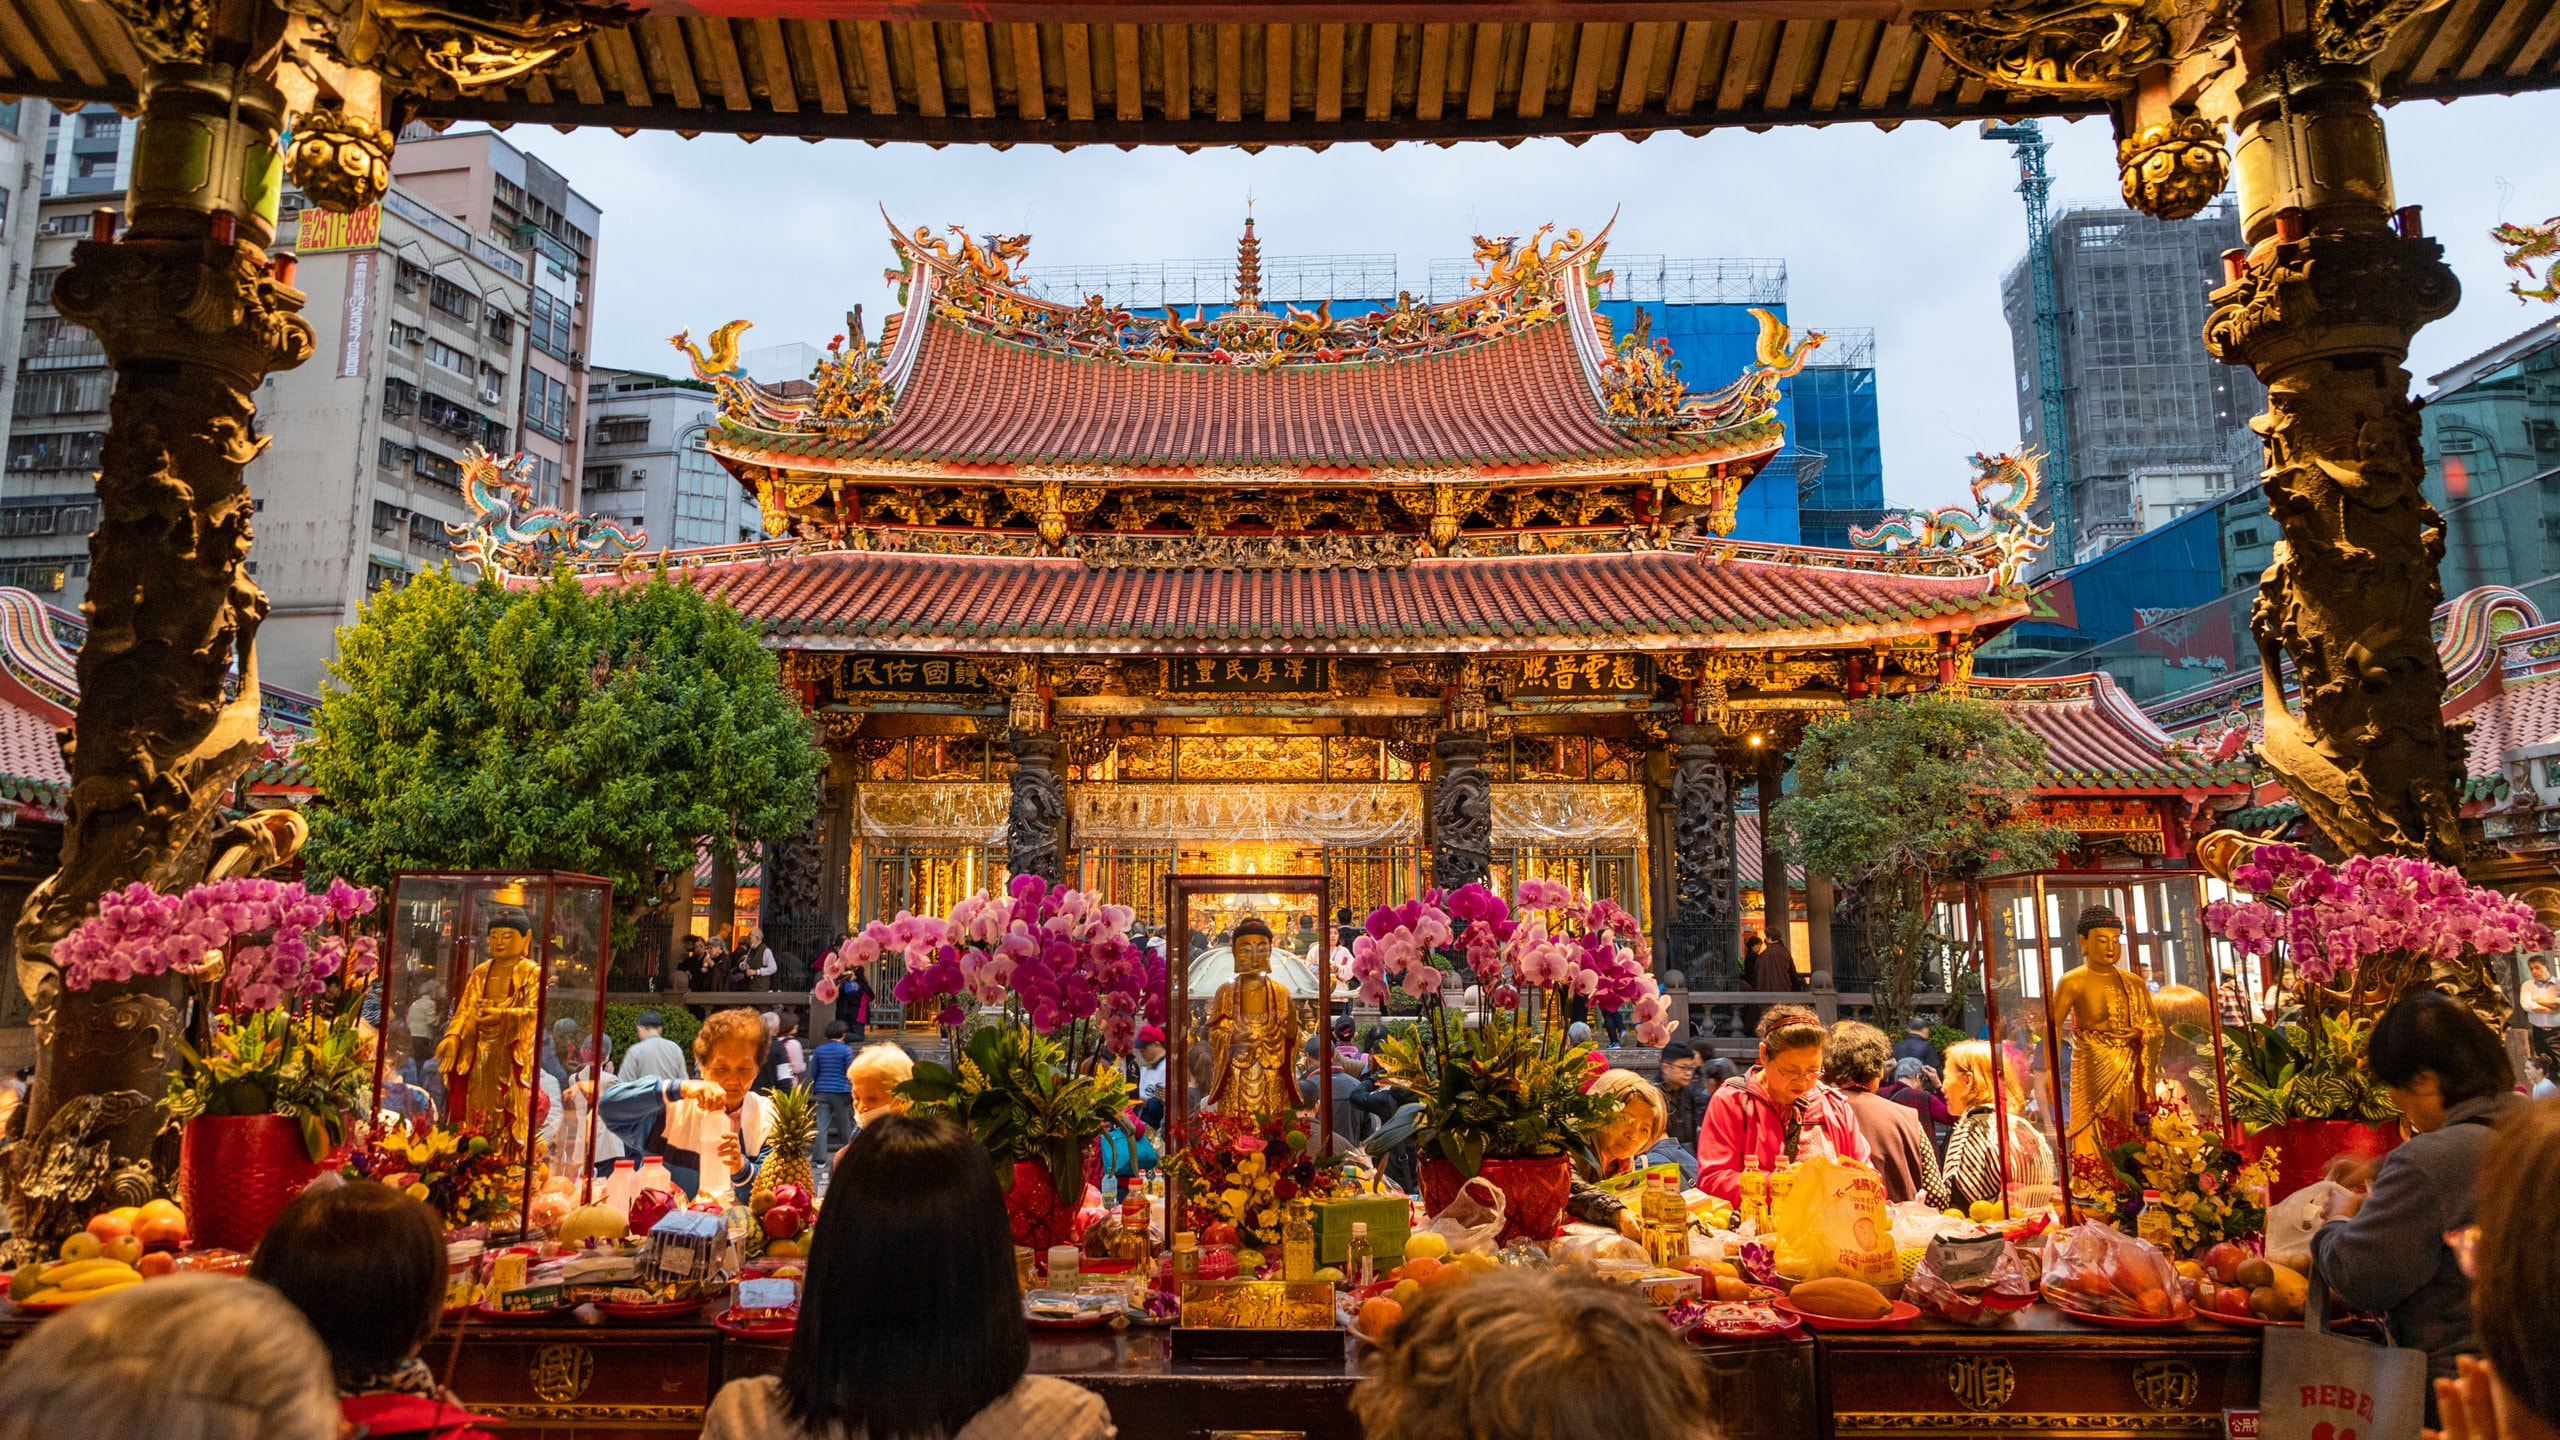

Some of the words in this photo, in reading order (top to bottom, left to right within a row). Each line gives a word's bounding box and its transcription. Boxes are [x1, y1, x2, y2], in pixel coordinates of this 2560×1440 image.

[851, 658, 984, 688] 護國佑民
[539, 1344, 582, 1394] 國
[1953, 1355, 2006, 1408] 順
